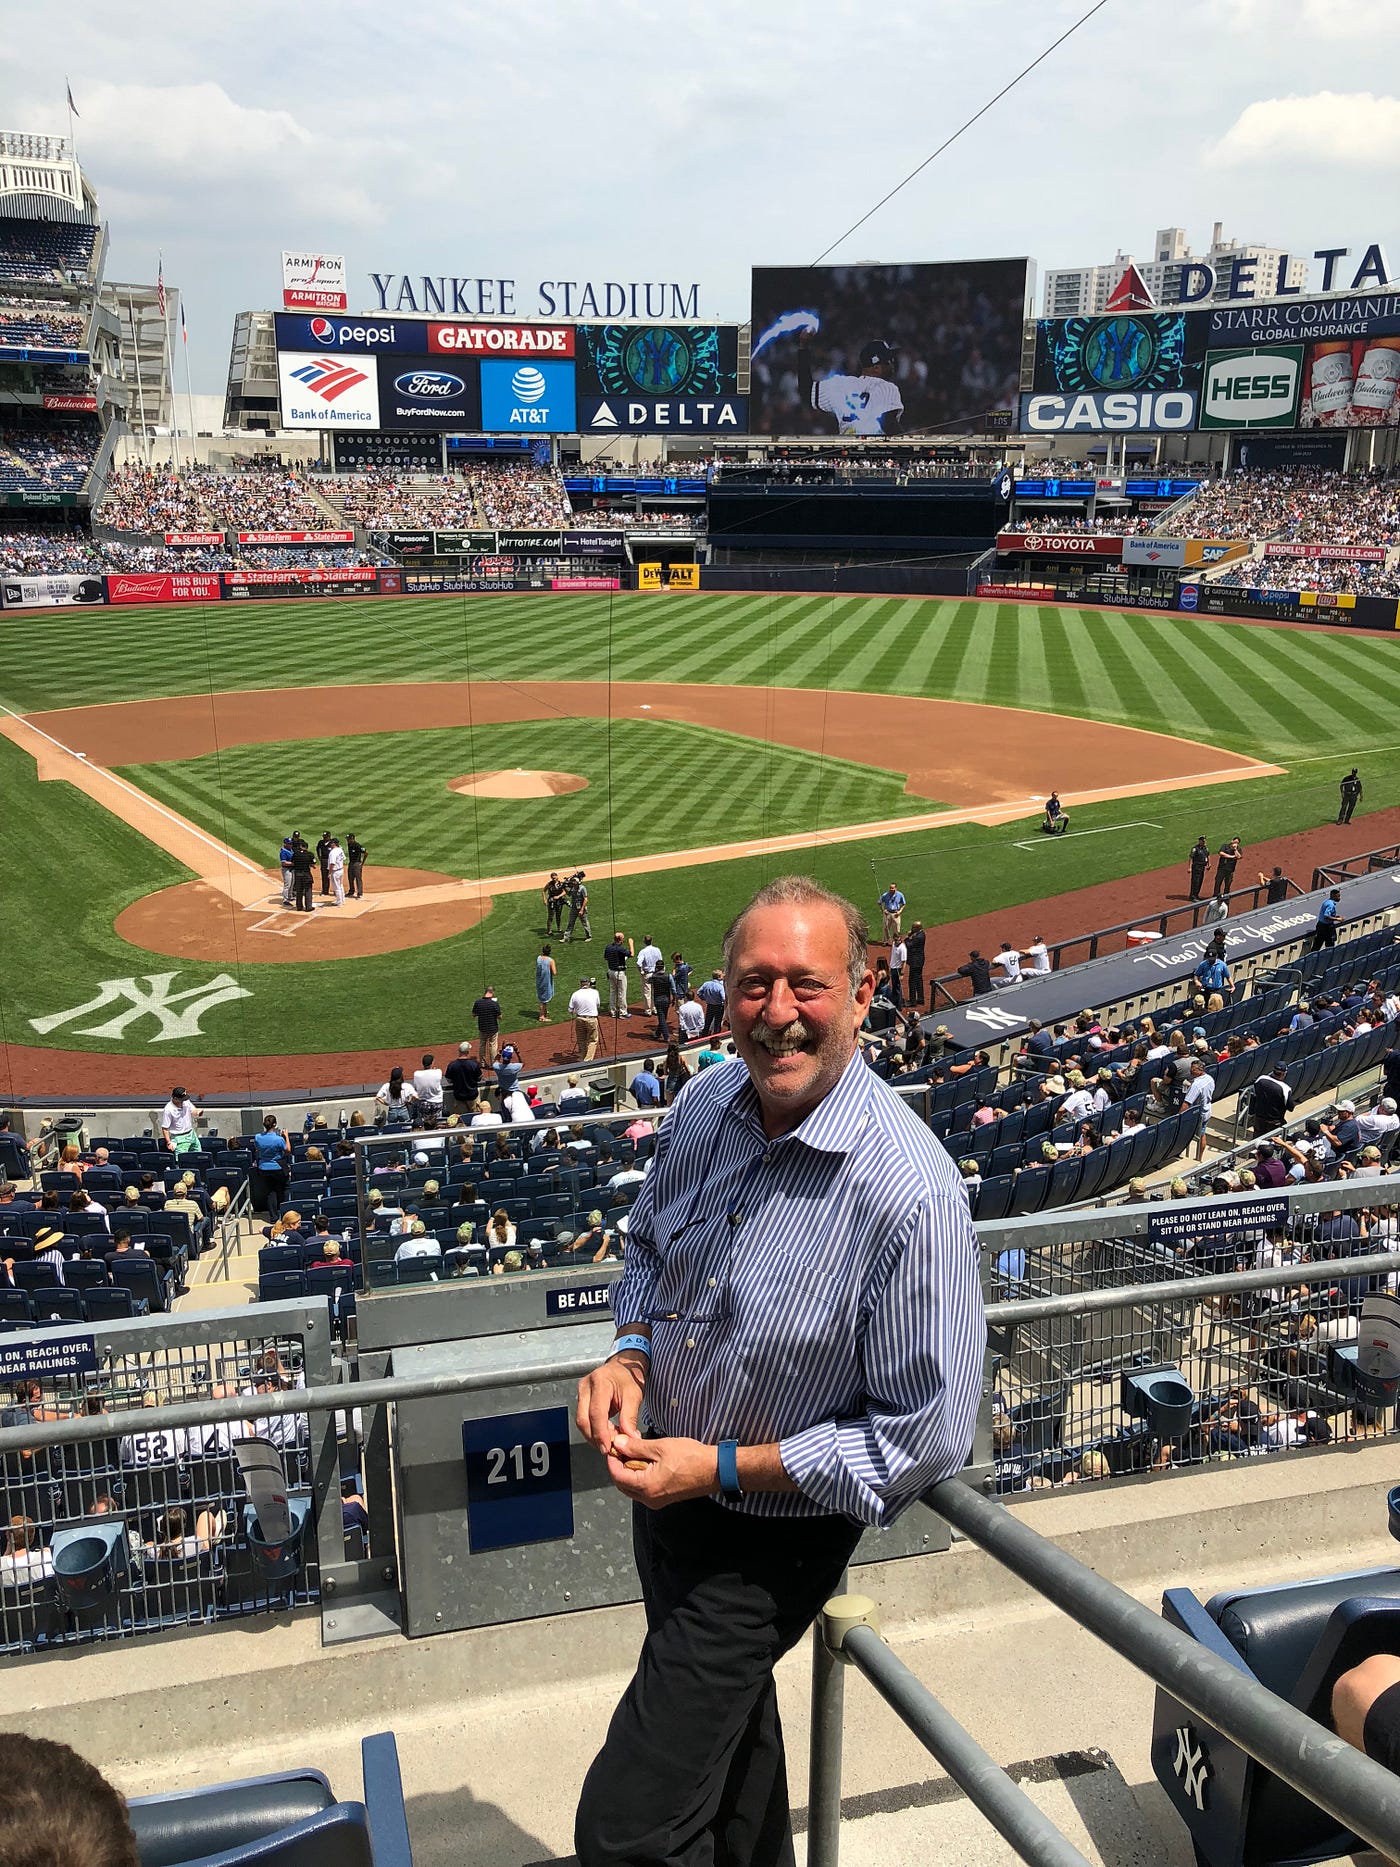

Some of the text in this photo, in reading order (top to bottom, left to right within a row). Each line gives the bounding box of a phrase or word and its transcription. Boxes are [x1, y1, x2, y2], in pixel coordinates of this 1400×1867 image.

[285, 258, 342, 269] ARMITRON
[1179, 244, 1391, 304] DELTA
[291, 292, 341, 302] ARMITRON
[368, 273, 701, 318] YANKEE STADIUM
[1212, 308, 1280, 330] STARR
[339, 324, 396, 346] pepsi
[437, 328, 567, 350] GATORADE
[1251, 322, 1369, 341] GLOBAL INSURANCE
[408, 375, 451, 396] Ford
[1212, 375, 1290, 401] HESS
[44, 397, 97, 409] Budweiser
[291, 408, 372, 421] Bank of America
[396, 407, 465, 418] BuyFordNow.com
[509, 408, 550, 424] AT&T
[629, 403, 738, 425] DELTA
[1027, 393, 1193, 430] CASIO
[499, 537, 560, 547] NITTOTIRE.COM
[580, 537, 622, 546] HotelTonight
[1045, 538, 1095, 550] TOYOTA
[1130, 541, 1180, 550] Bank of America
[1203, 549, 1225, 562] SAP
[1269, 545, 1382, 558] MODELL'S MODELLS.com
[1106, 564, 1128, 573] FedEx
[117, 583, 161, 593] Budweiser
[171, 576, 218, 587] THIS BUD'S
[408, 581, 514, 592] StubHub StubHub StubHub
[172, 587, 211, 597] FOR YOU.
[1270, 591, 1290, 599] pepsi
[1103, 594, 1169, 607] StubHub StubHub
[1133, 942, 1197, 969] New
[1243, 912, 1318, 944] Yankees
[1152, 1203, 1287, 1226] PLEASE DO NOT LEAN ON, REACH OVER,
[1161, 1214, 1278, 1235] SIT ON OR STAND NEAR RAILINGS.
[558, 1293, 576, 1309] BE
[5, 1343, 91, 1361] ON, REACH OVER,
[0, 1356, 80, 1374] NEAR RAILINGS.
[135, 1435, 168, 1462] 52
[487, 1441, 550, 1485] 219
